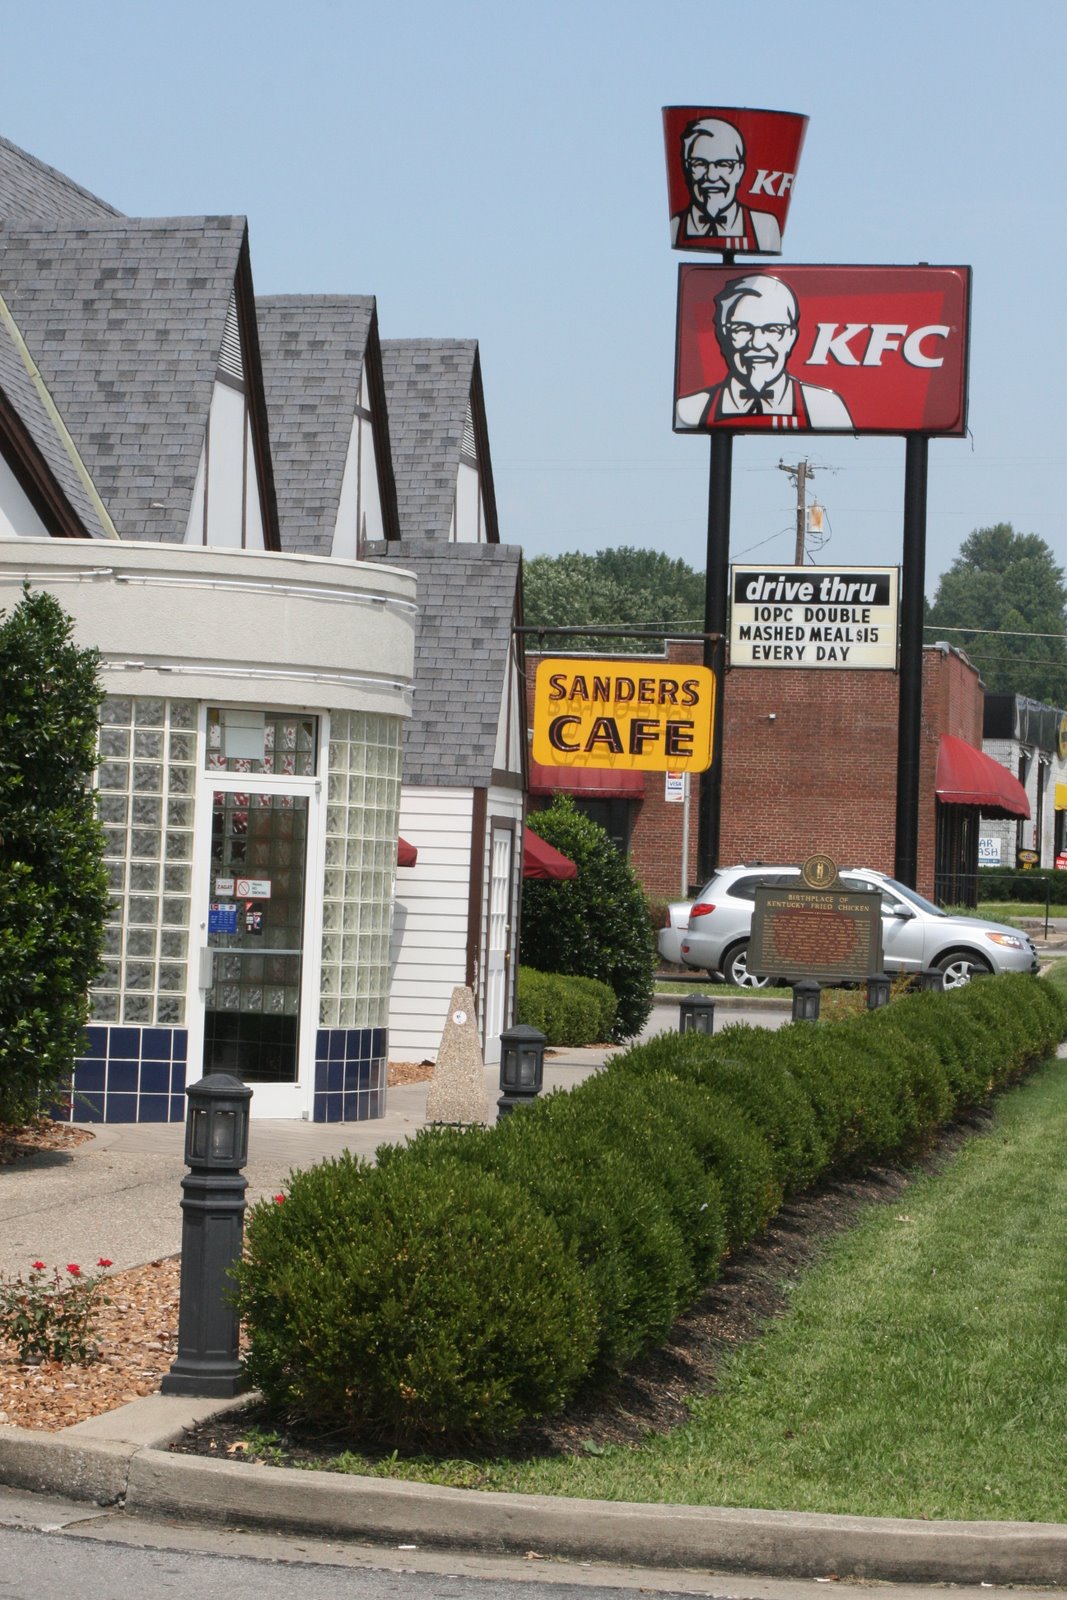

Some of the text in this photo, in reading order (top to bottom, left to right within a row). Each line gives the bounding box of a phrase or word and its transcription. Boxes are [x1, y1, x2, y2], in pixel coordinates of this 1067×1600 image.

[748, 169, 796, 197] KF
[805, 323, 950, 368] KFC
[746, 575, 877, 602] drive thru
[804, 608, 871, 624] DOUBLE
[739, 625, 879, 643] MASHED MEAL $15
[752, 645, 850, 662] EVERY DAY
[549, 673, 700, 707] SANDERS
[548, 714, 695, 758] CAFE
[978, 847, 998, 857] ASH
[979, 839, 993, 848] AR
[767, 900, 870, 912] KENTUCKY FRIED CHICKEN
[788, 894, 834, 903] BIRTHPLACE
